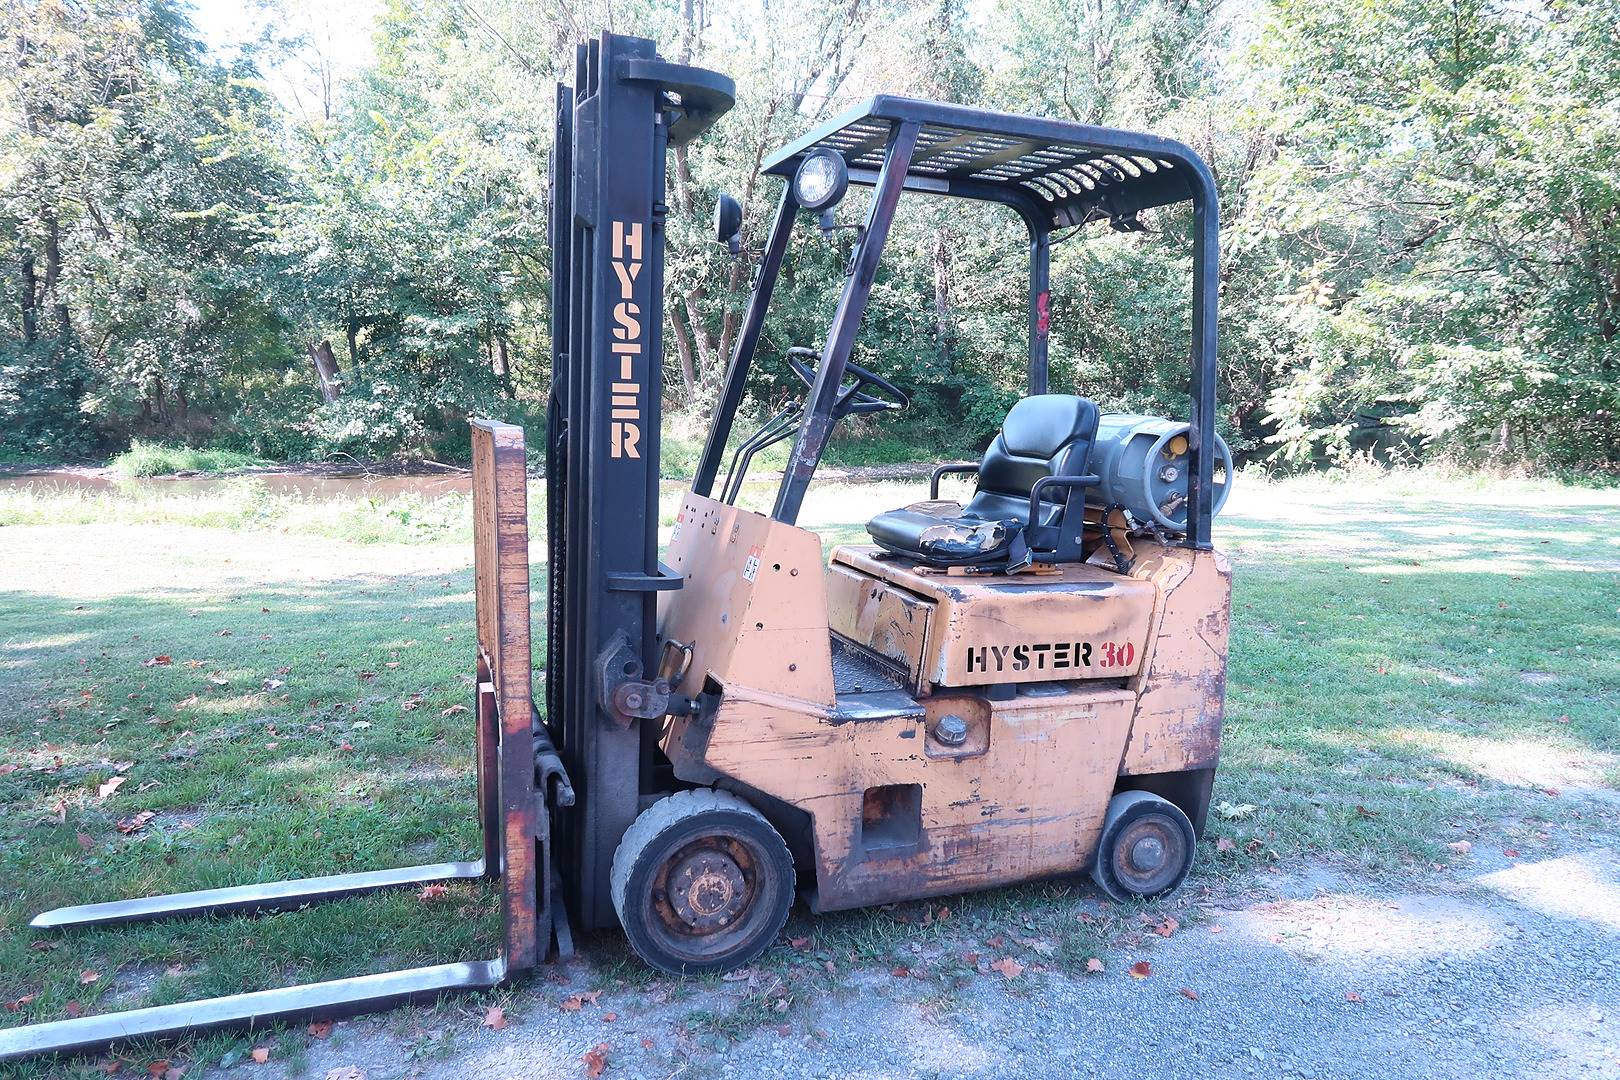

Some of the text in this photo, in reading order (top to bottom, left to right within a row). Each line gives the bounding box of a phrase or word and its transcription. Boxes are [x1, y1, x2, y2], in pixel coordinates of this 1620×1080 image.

[611, 221, 642, 458] HYSTER
[967, 641, 1135, 672] HYSTER 30
